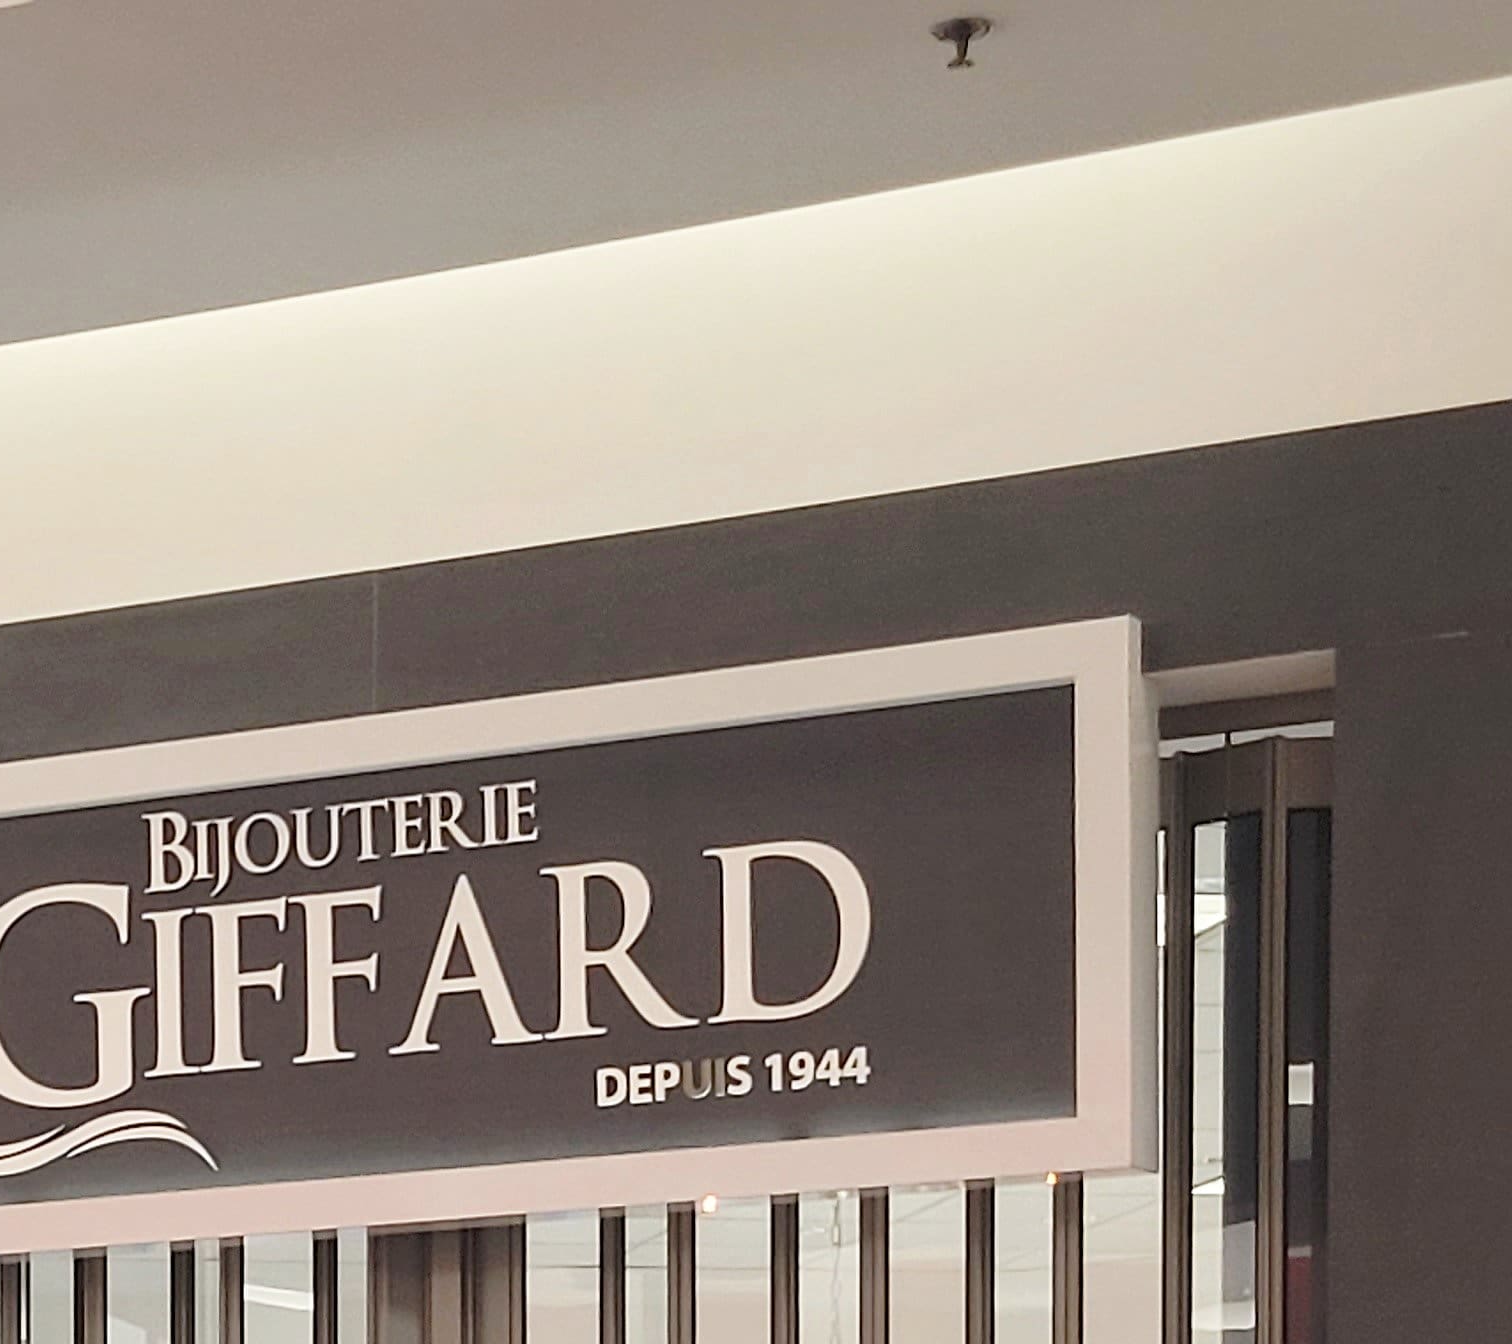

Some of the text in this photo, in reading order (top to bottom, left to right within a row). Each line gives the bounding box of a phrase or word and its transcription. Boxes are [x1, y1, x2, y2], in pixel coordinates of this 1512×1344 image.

[141, 778, 540, 897] BIJOUTERIE
[595, 1045, 872, 1108] DEPUIS 1944
